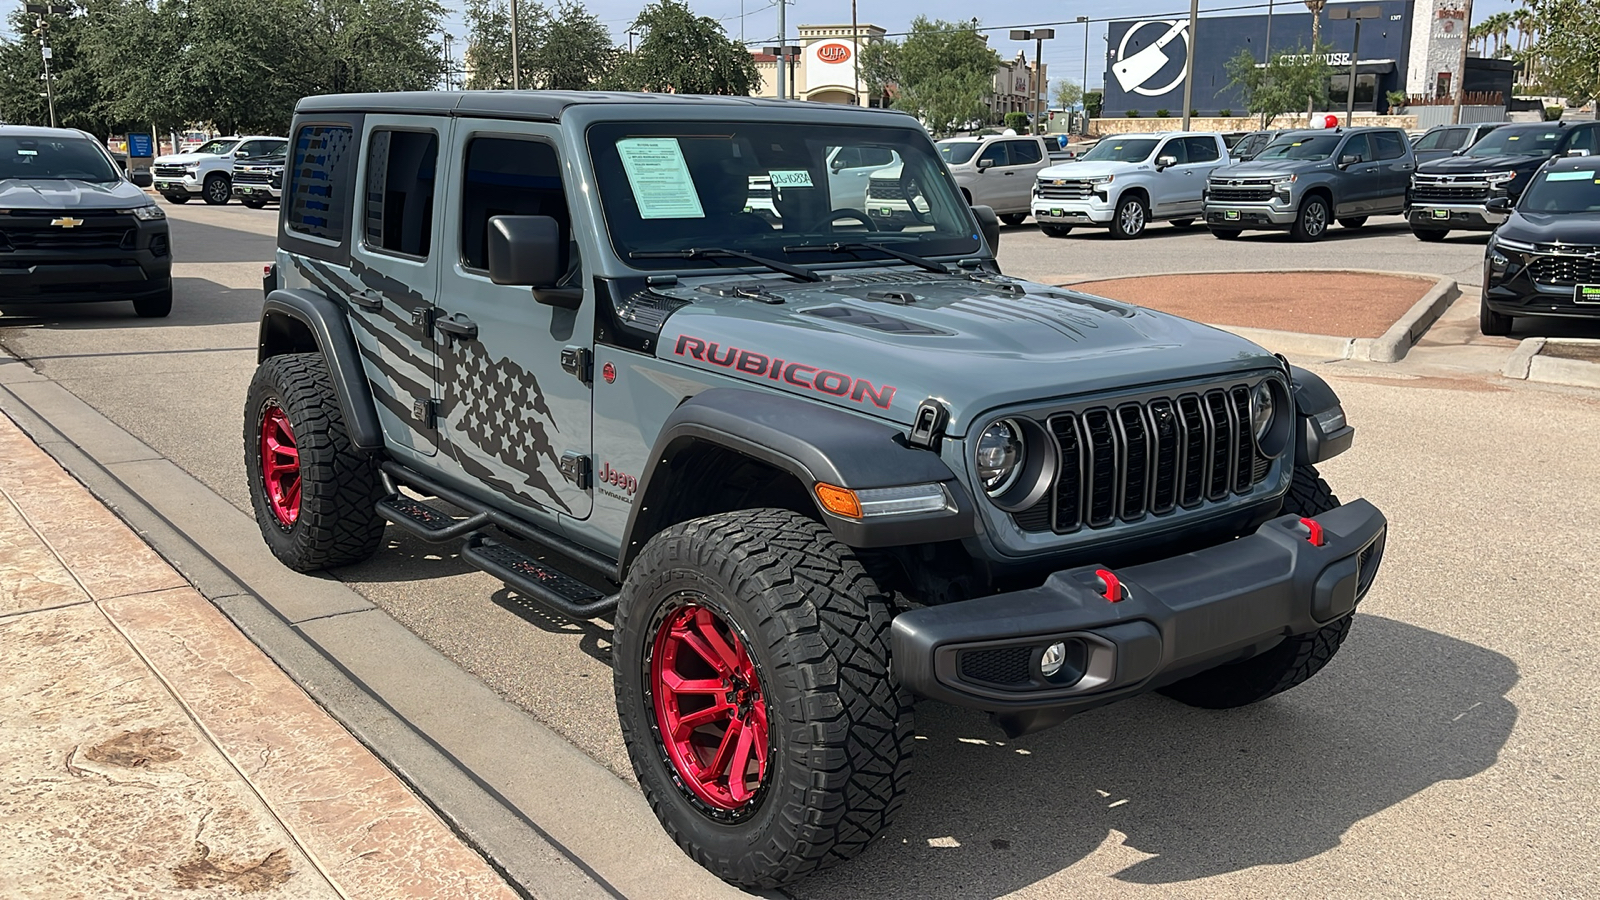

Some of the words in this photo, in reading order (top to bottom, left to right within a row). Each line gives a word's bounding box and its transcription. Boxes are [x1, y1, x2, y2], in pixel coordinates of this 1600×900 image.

[822, 47, 846, 57] ULTA
[674, 334, 897, 410] RUBICON
[598, 461, 637, 497] Jeep
[603, 489, 633, 505] WRANGL
